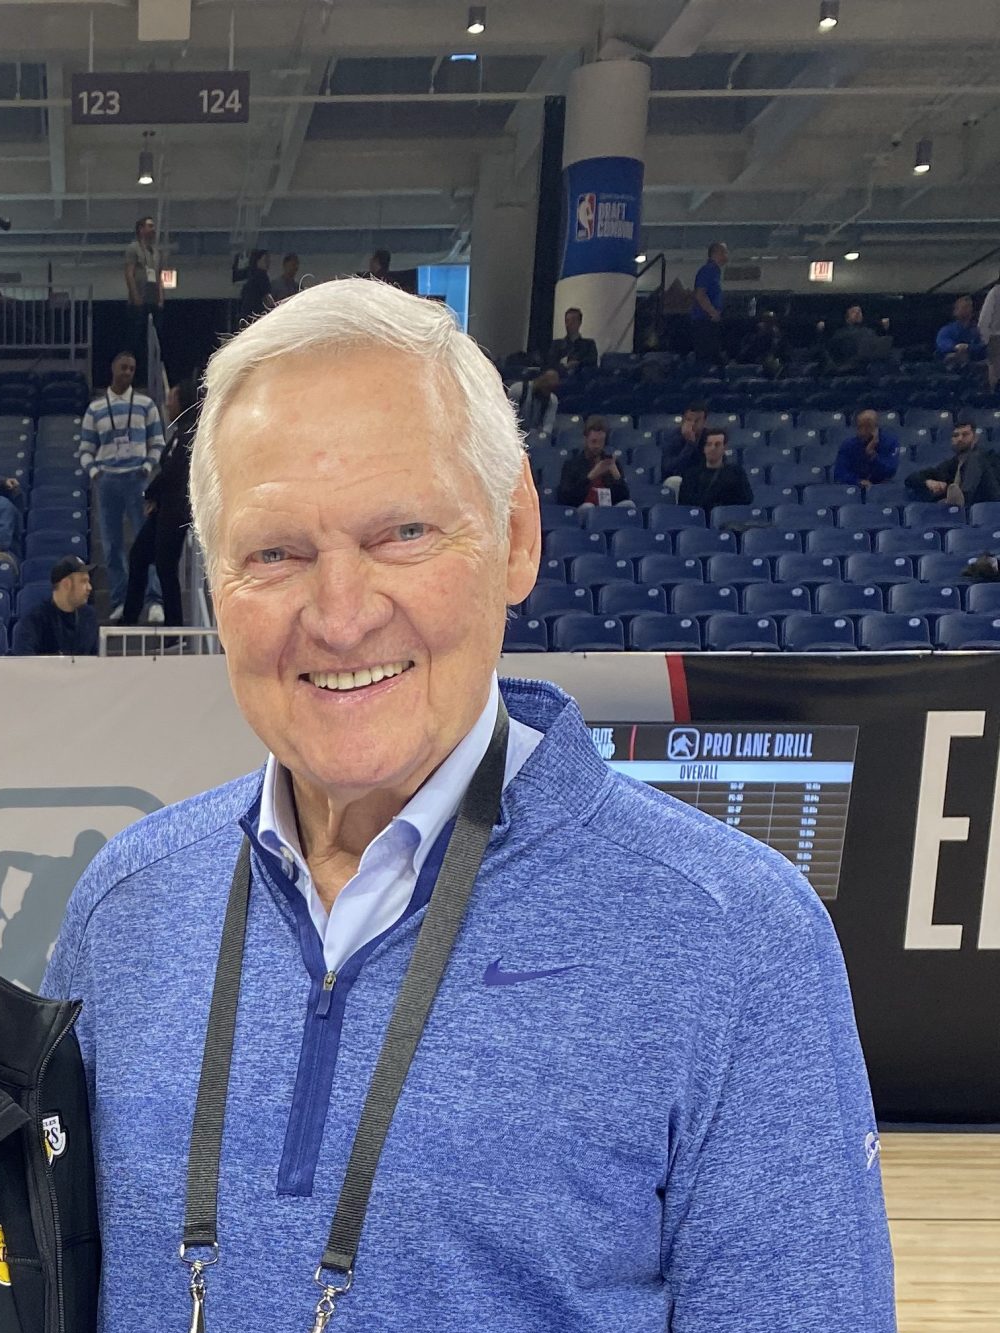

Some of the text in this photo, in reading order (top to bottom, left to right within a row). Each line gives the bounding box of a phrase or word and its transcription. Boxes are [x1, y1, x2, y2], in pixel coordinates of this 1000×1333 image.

[79, 89, 242, 115] 123 124
[592, 727, 614, 743] ELITE
[597, 743, 616, 759] AMP
[702, 732, 813, 758] PRO LANE DRILL
[680, 764, 719, 780] OVERALL
